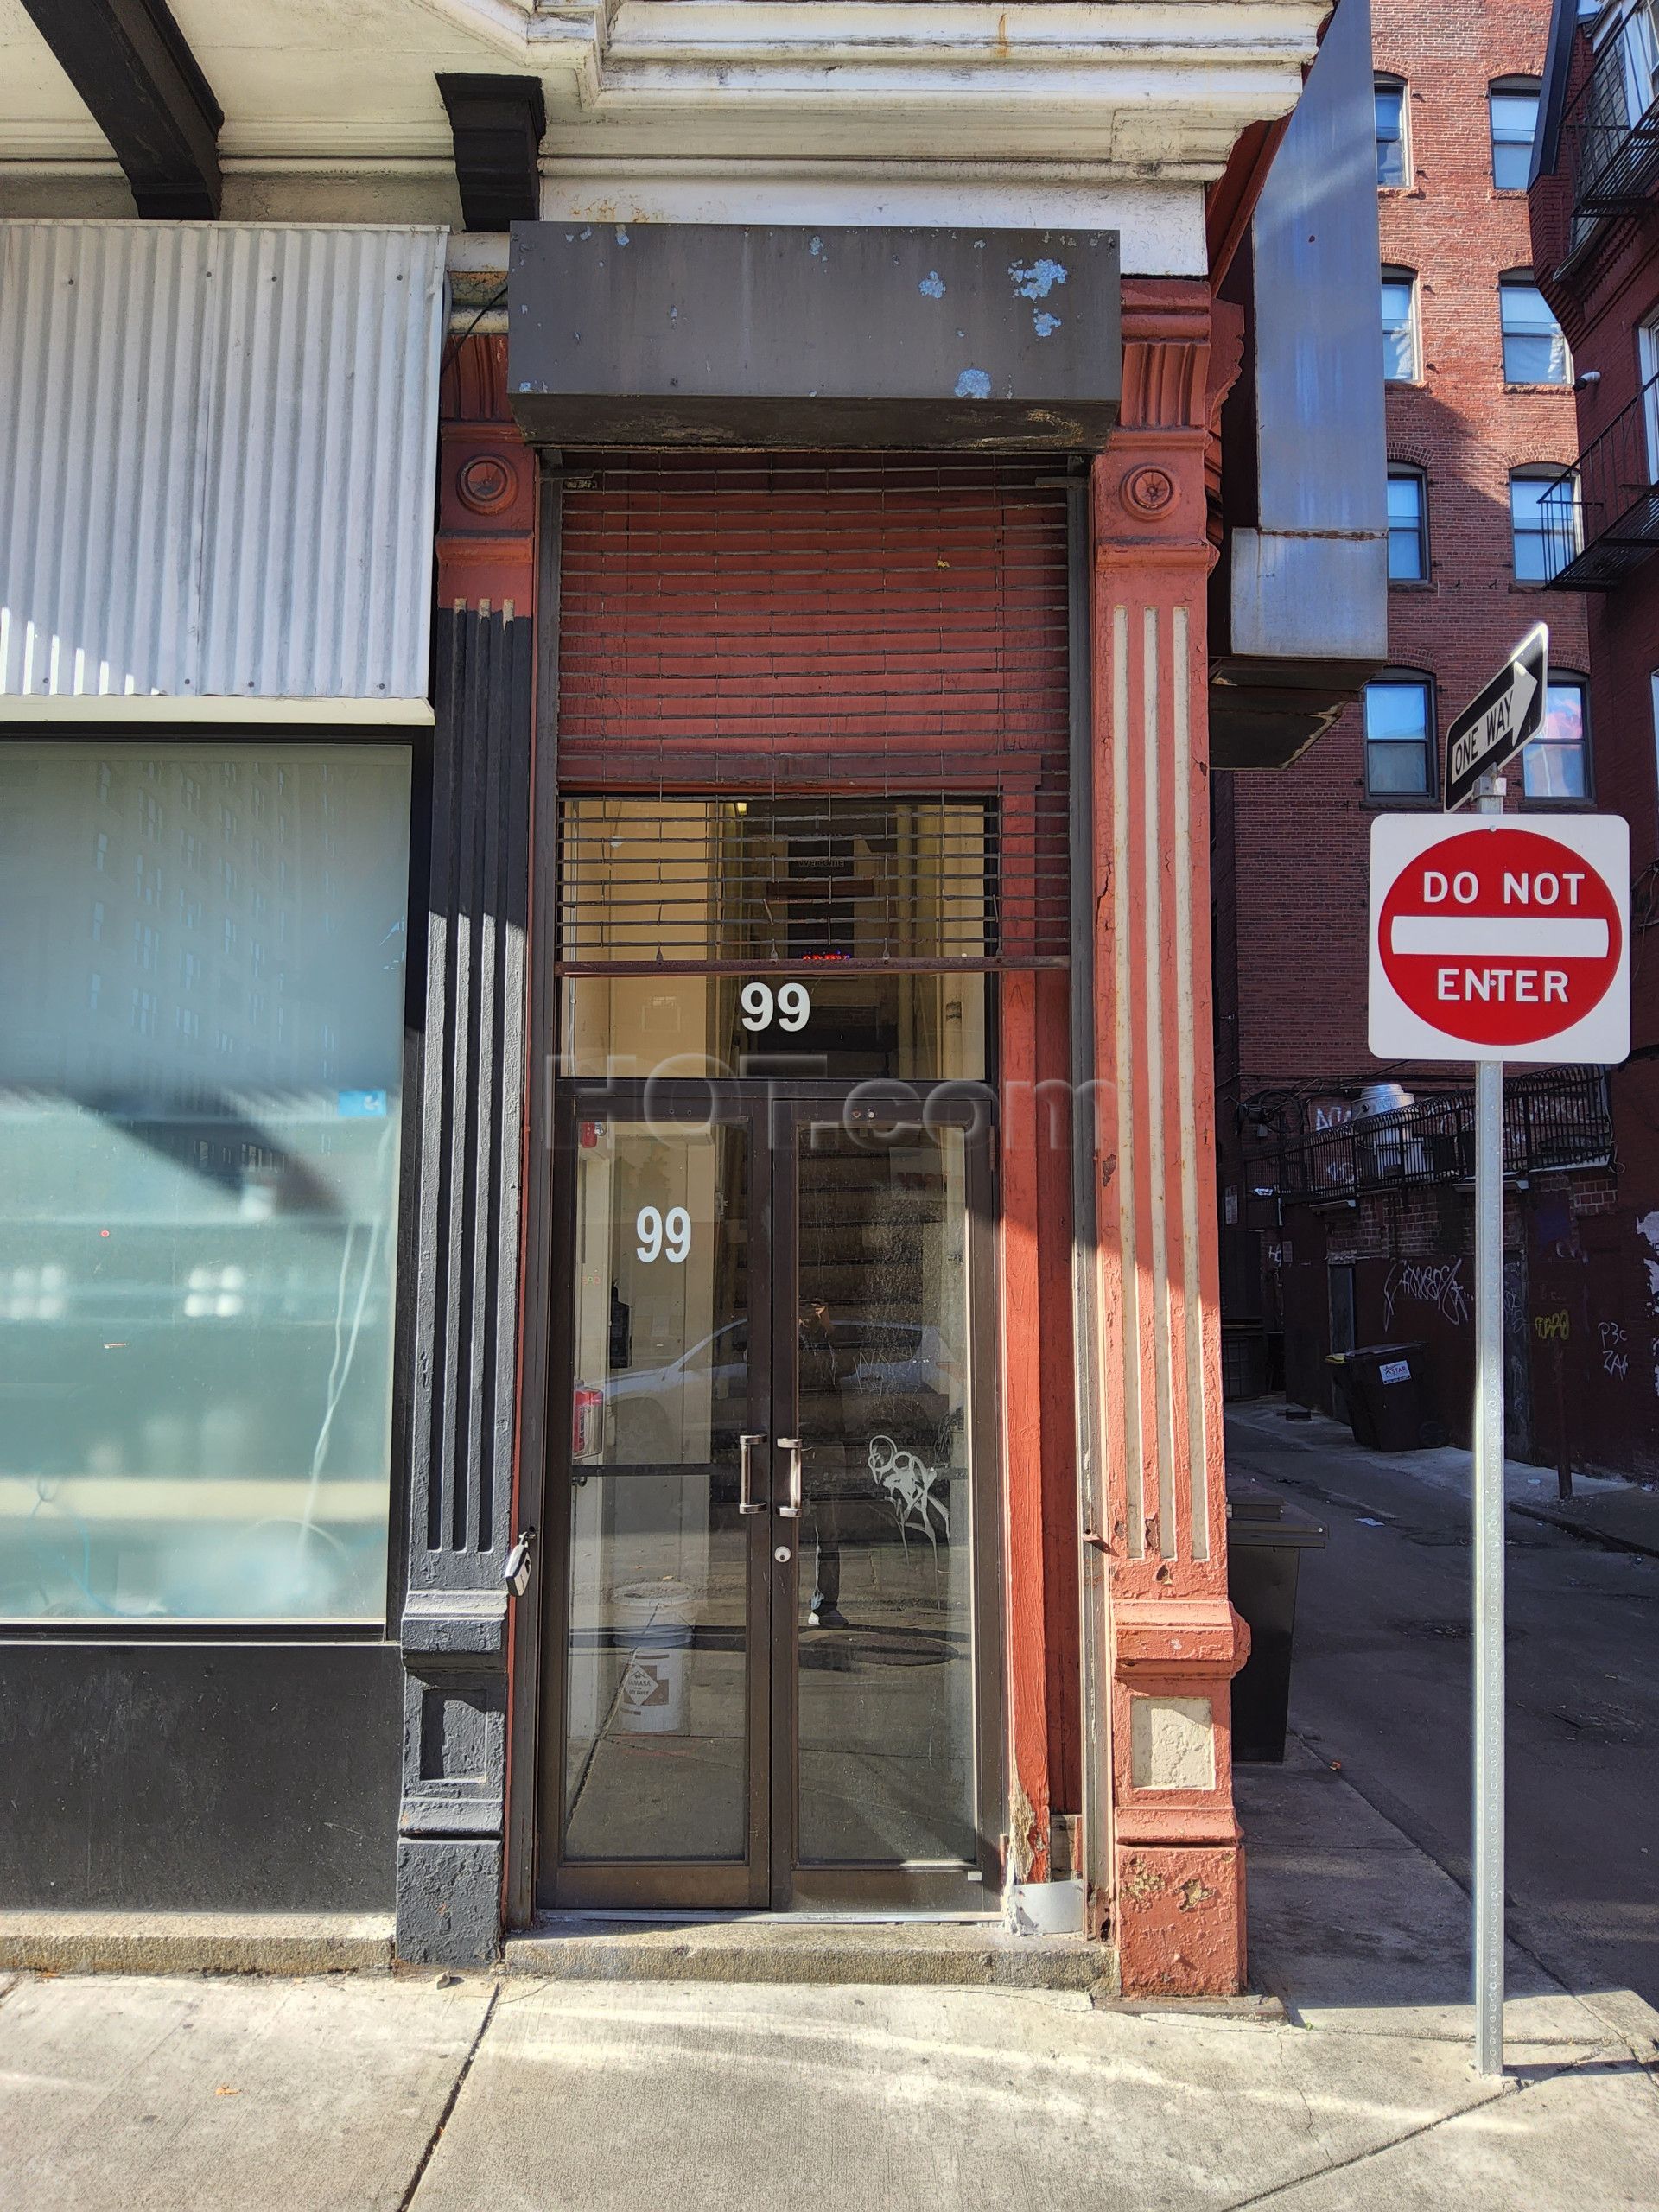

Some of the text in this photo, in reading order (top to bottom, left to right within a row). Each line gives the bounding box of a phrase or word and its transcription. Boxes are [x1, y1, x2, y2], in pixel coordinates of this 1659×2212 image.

[1455, 690, 1513, 775] ONE WAY
[1423, 871, 1585, 905] DO NOT
[741, 982, 810, 1032] 99
[1438, 968, 1568, 1003] ENTER
[636, 1206, 691, 1263] 99
